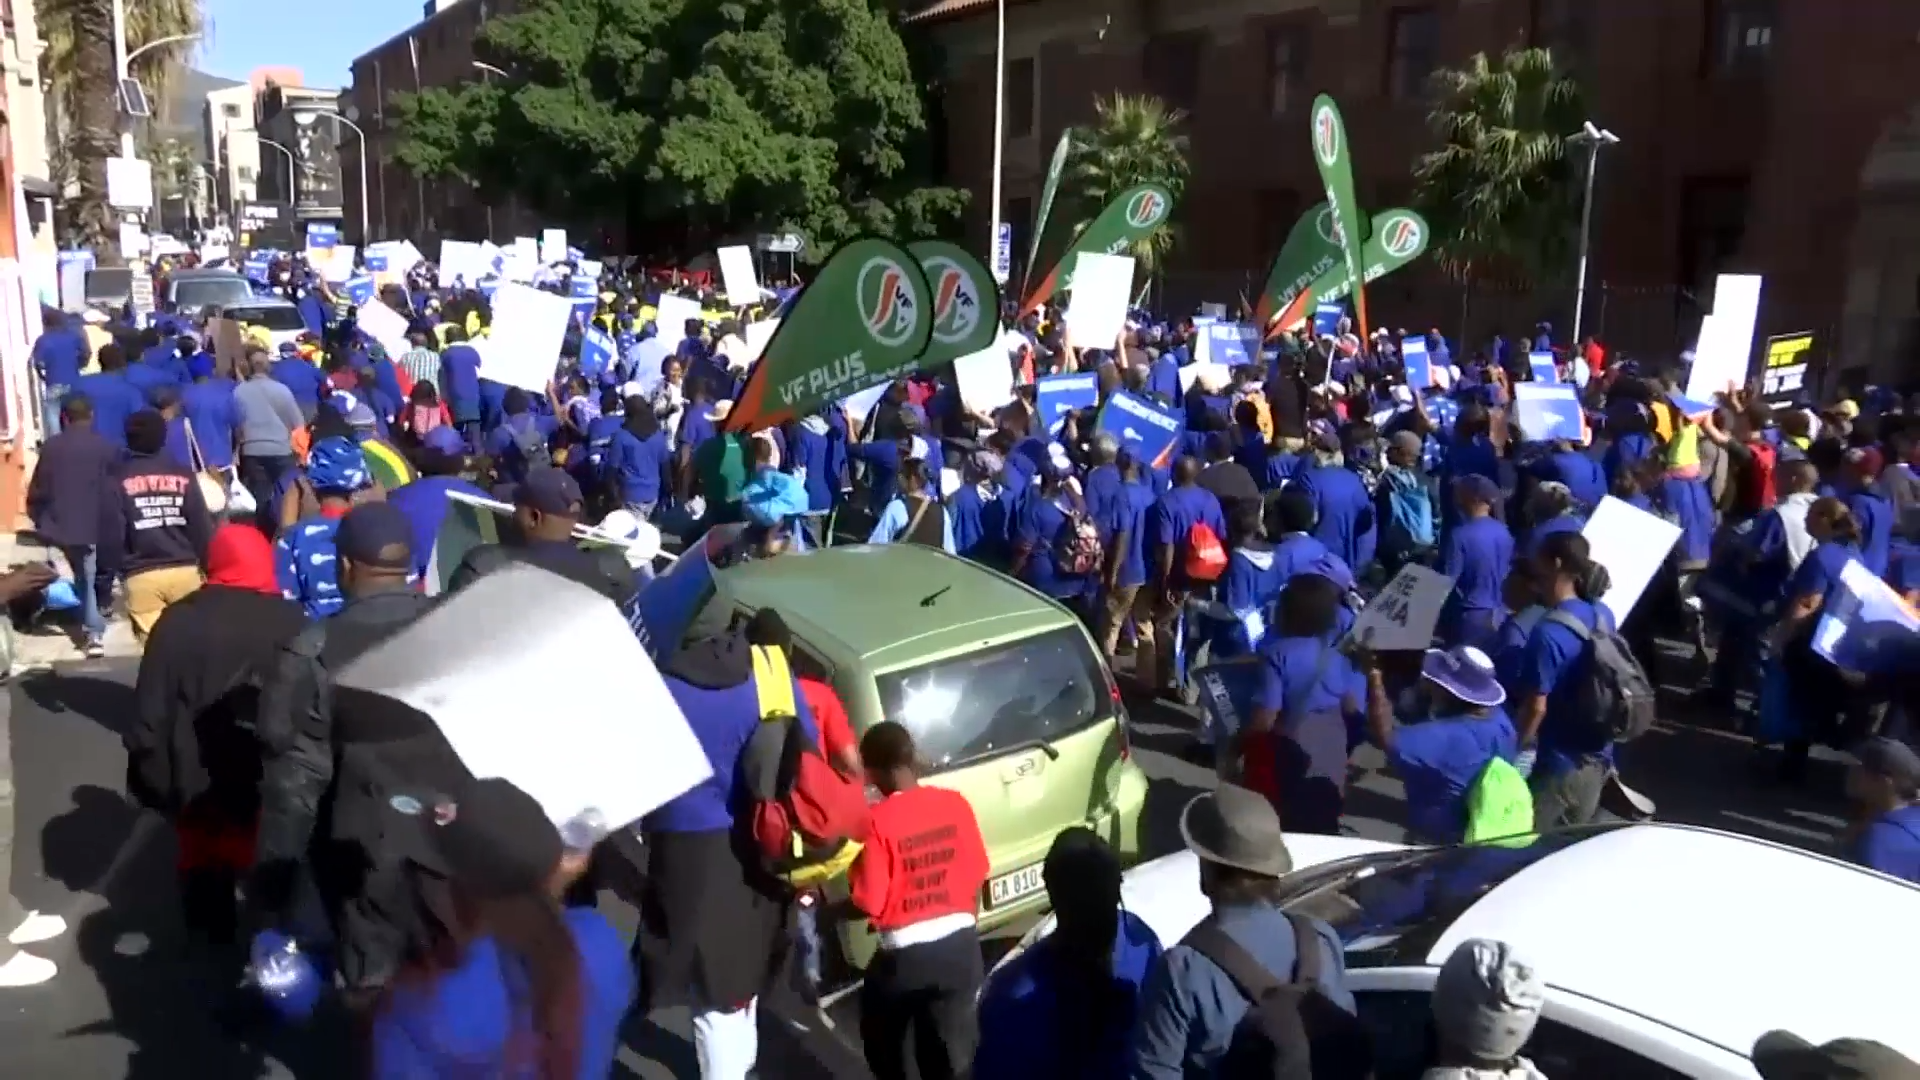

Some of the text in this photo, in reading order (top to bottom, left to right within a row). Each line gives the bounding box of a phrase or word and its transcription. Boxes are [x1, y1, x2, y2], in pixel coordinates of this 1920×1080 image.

[779, 375, 805, 405] VF
[808, 349, 867, 394] PLUS
[992, 869, 1038, 901] CA 810
